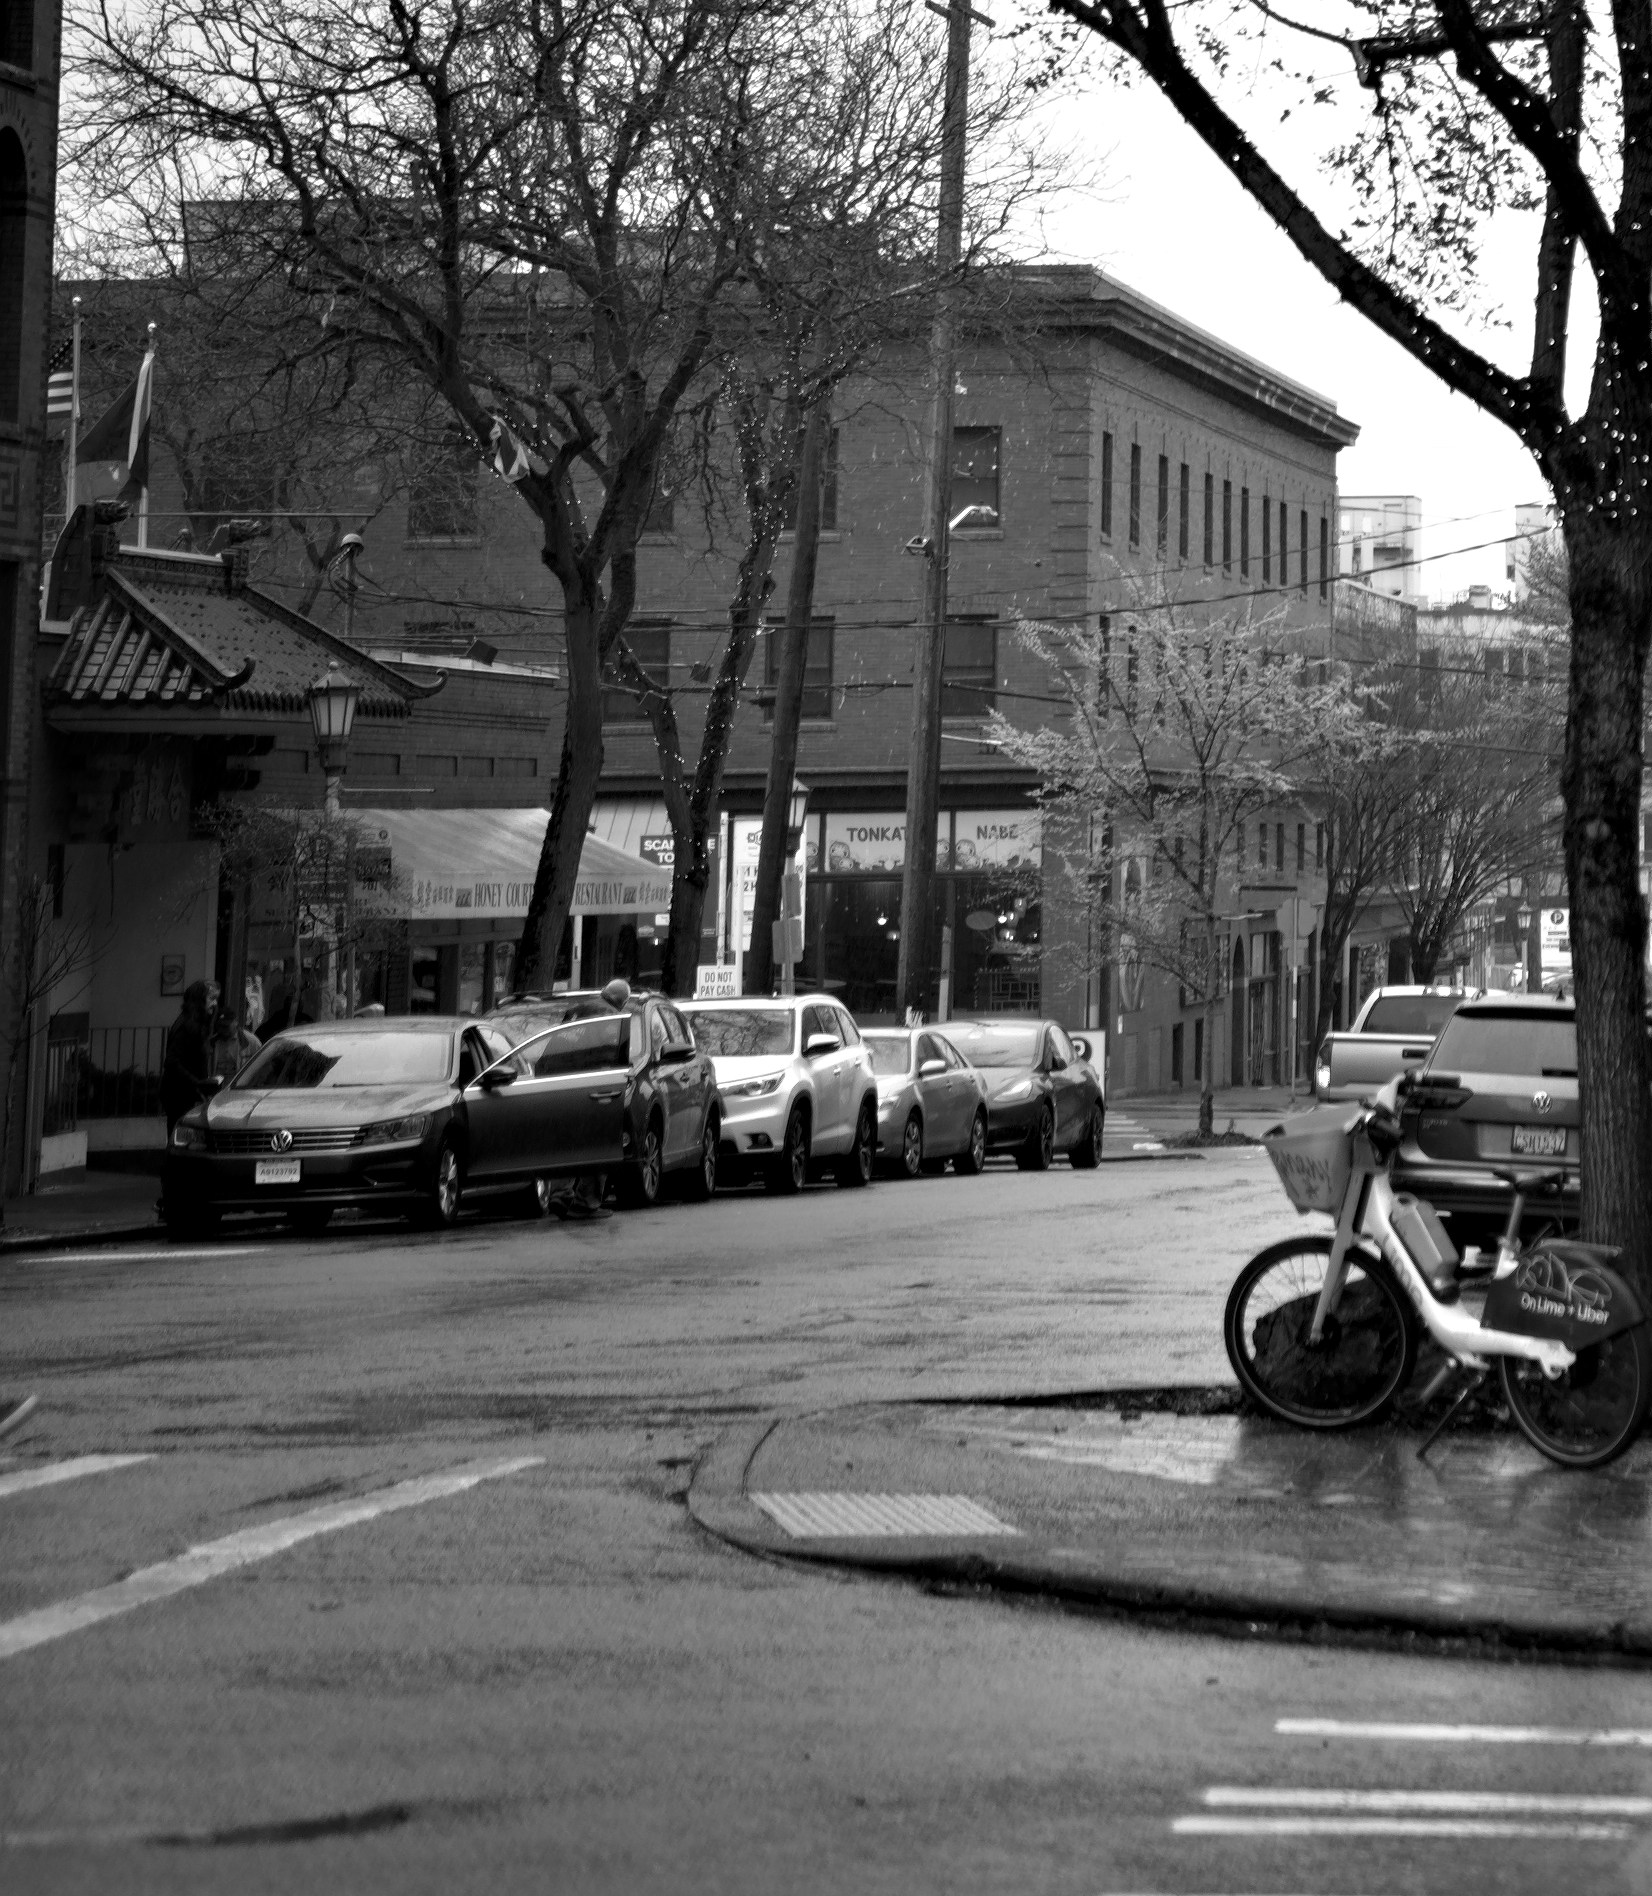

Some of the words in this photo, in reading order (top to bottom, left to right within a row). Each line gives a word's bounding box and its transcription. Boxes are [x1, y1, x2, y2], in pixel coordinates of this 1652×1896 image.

[474, 883, 502, 907] HONEY
[574, 882, 623, 905] RESTAURANT
[704, 972, 716, 983] DO
[717, 972, 733, 983] NOT
[700, 987, 714, 997] PAY
[716, 986, 736, 996] CASH
